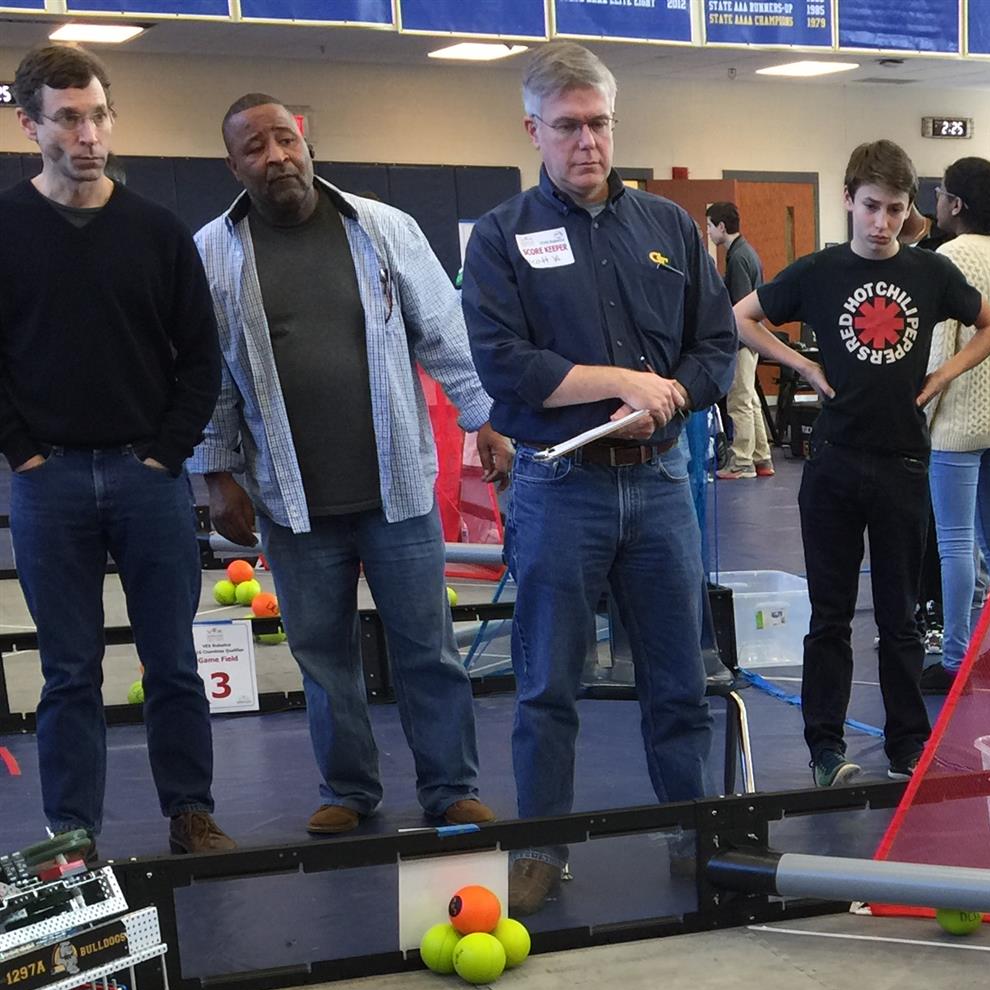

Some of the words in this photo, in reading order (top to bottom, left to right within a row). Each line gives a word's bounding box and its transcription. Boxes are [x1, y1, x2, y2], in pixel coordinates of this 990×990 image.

[709, 1, 732, 11] STATE
[750, 2, 793, 14] RUNNERS-UP
[709, 13, 733, 25] STATE
[755, 16, 794, 27] CHAMPIONS
[807, 17, 826, 28] 1979
[522, 246, 544, 256] SCORE
[544, 243, 568, 253] KEEPER
[843, 282, 874, 313] HOT
[875, 281, 918, 316] CHILI
[839, 313, 861, 353] RED
[857, 317, 919, 364] PEPPERS
[198, 656, 220, 664] Game
[210, 671, 232, 699] 3
[79, 932, 127, 957] BULLDOGS
[5, 960, 46, 985] 1297A
